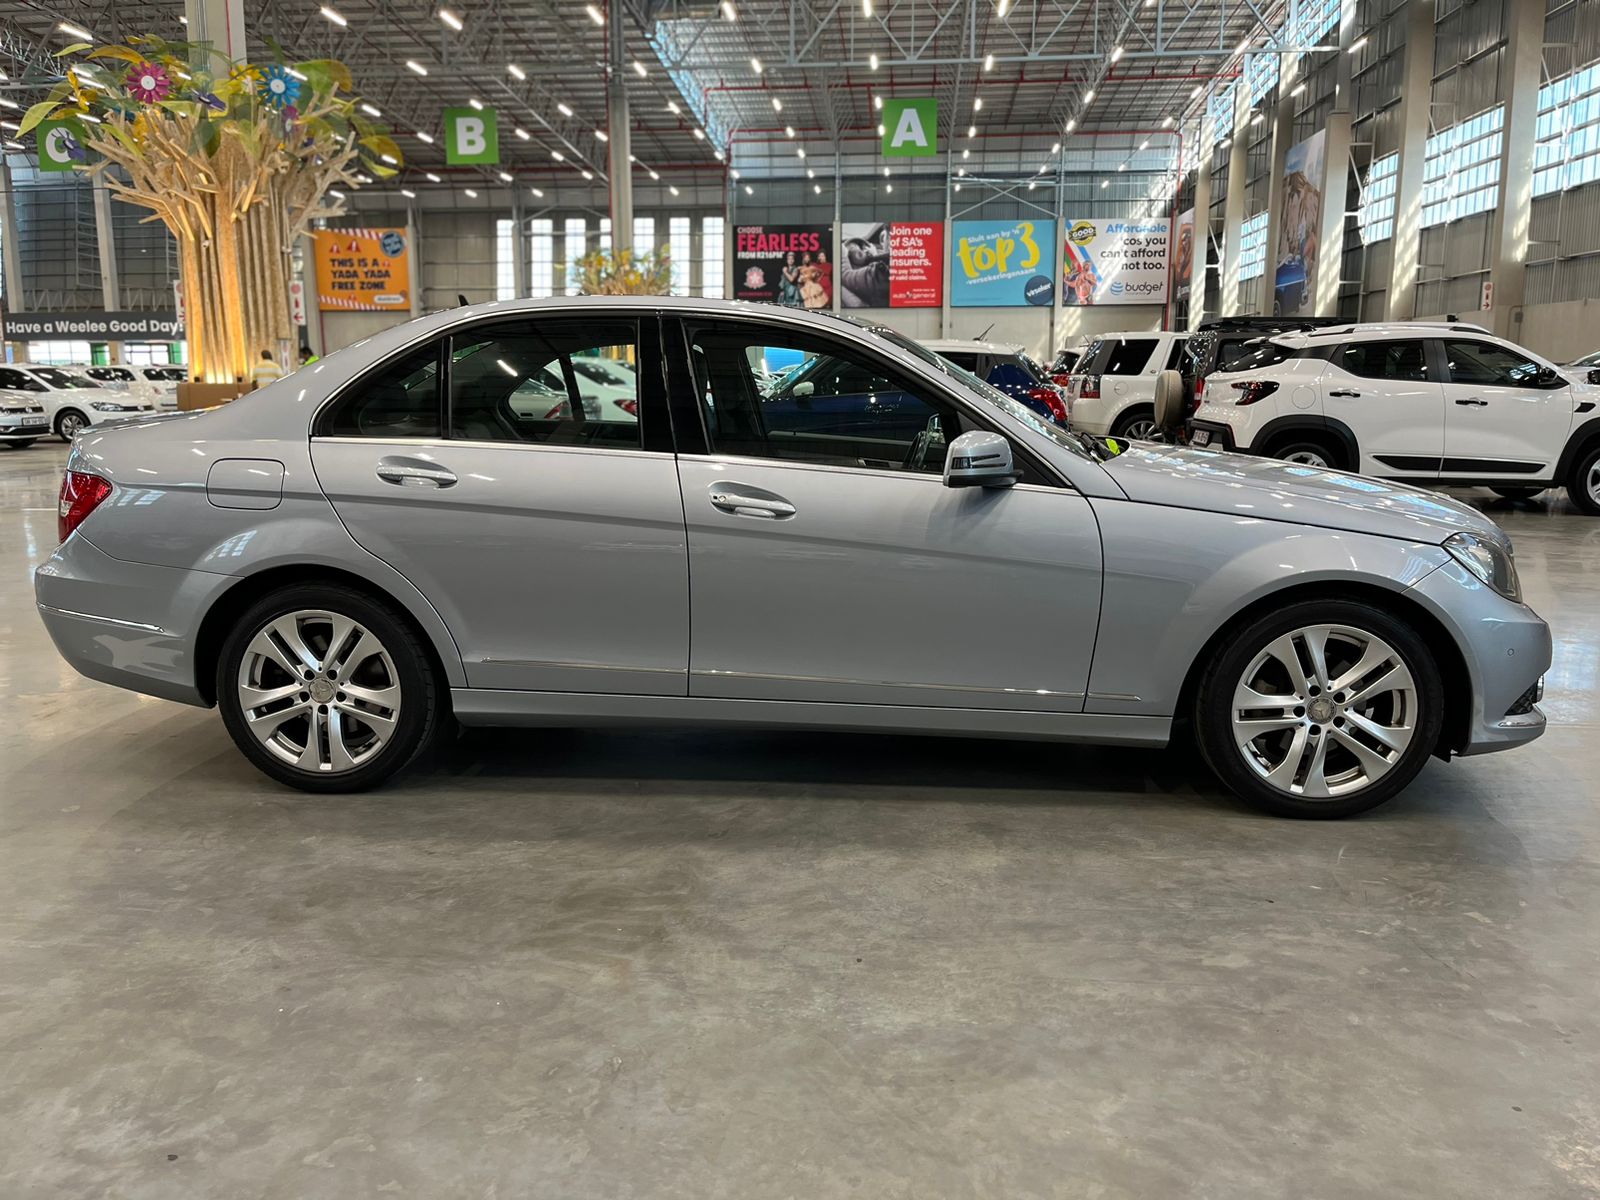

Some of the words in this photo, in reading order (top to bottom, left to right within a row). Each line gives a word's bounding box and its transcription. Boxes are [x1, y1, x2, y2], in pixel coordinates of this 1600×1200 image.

[890, 108, 928, 147] A
[456, 117, 486, 155] B
[890, 226, 911, 235] Join
[913, 227, 932, 235] one
[737, 233, 820, 251] FEARLESS
[890, 237, 900, 247] of
[902, 237, 923, 247] SA's
[1145, 237, 1167, 248] you
[889, 248, 926, 258] leading
[957, 237, 1016, 278] top
[1016, 222, 1041, 269] 3
[1131, 248, 1166, 258] afford
[330, 259, 354, 267] THIS
[358, 259, 368, 267] IS
[372, 259, 379, 267] A
[889, 259, 932, 267] insurers.
[1121, 261, 1141, 270] not
[1143, 261, 1165, 270] too.
[331, 270, 359, 278] YADA
[364, 270, 391, 278] YADA
[332, 282, 355, 290] FREE
[360, 282, 385, 290] ZONE
[1125, 281, 1164, 296] budget
[6, 322, 41, 333] Have
[43, 324, 53, 333] a
[55, 320, 107, 333] Weelee
[110, 321, 147, 332] Good
[150, 320, 184, 336] Day!
